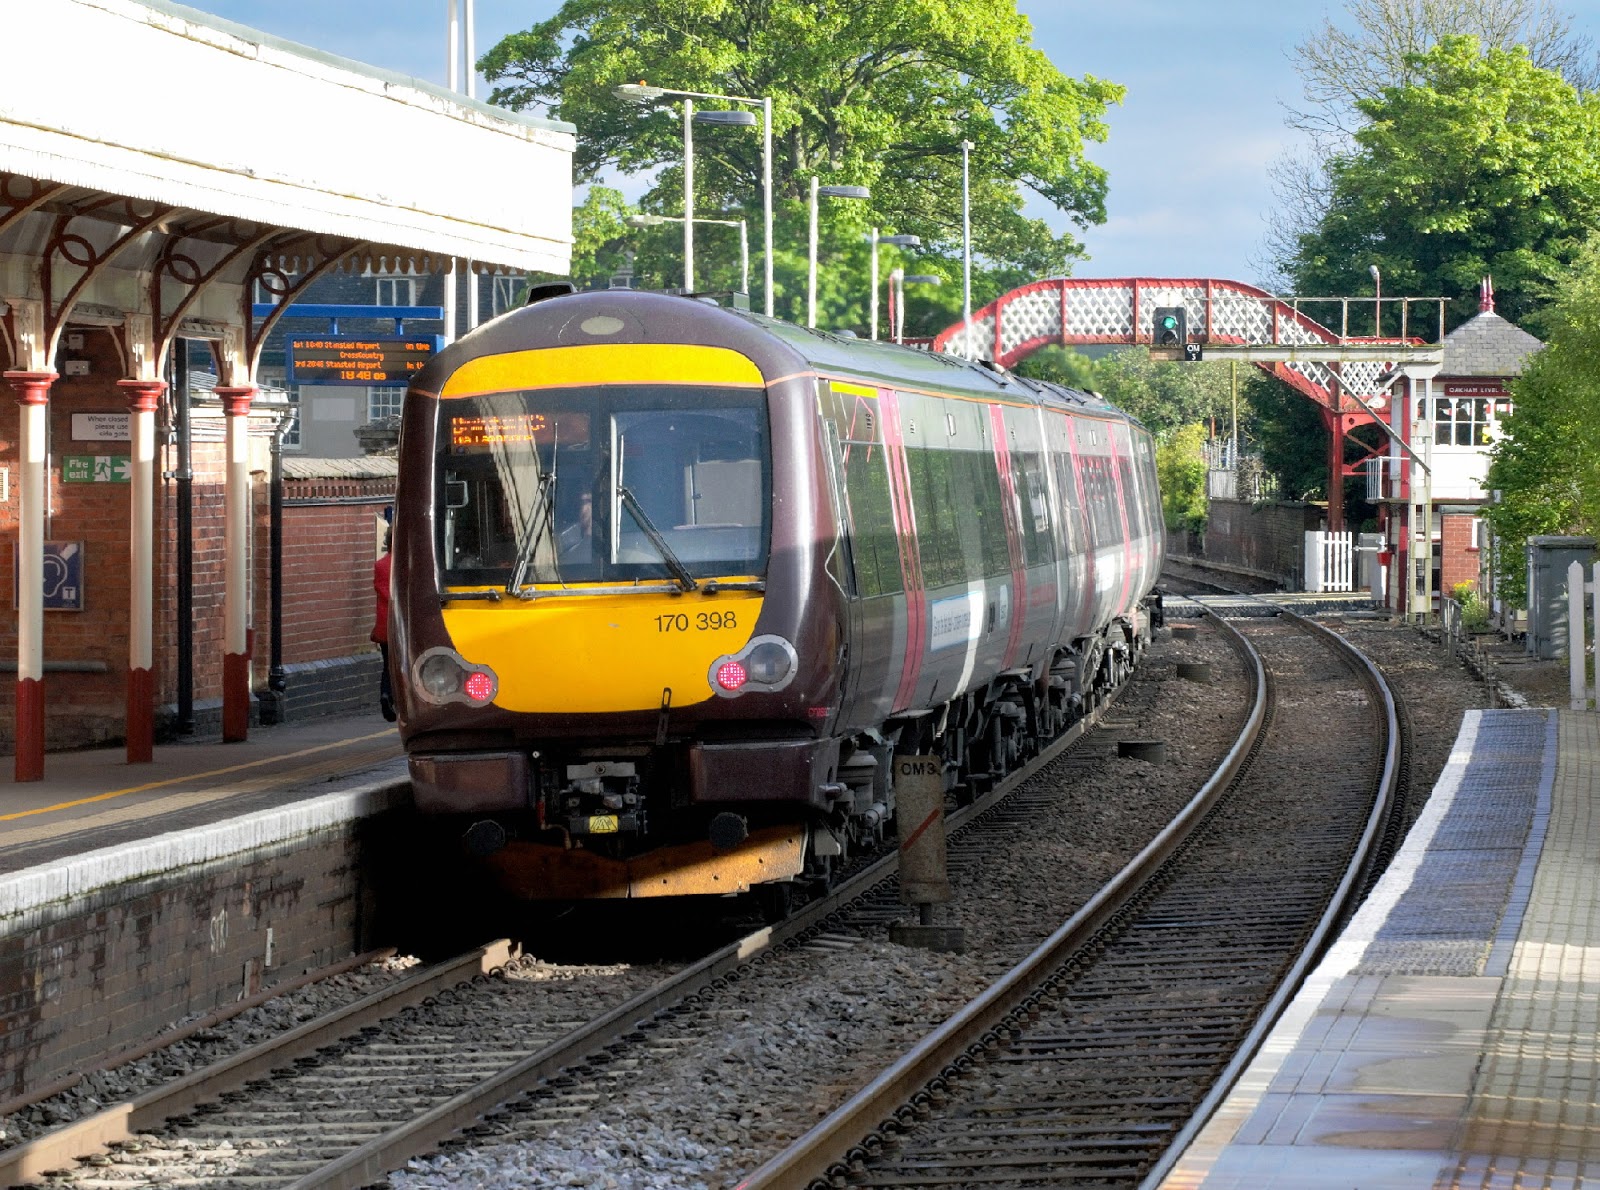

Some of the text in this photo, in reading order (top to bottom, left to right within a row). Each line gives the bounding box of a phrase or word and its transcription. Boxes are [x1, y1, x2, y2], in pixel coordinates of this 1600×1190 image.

[356, 342, 380, 350] Airport
[340, 351, 384, 361] CrossCountry
[357, 361, 381, 370] Airport
[69, 459, 88, 468] Fire
[69, 470, 88, 479] exit
[65, 588, 73, 598] T
[654, 611, 737, 632] 170 398
